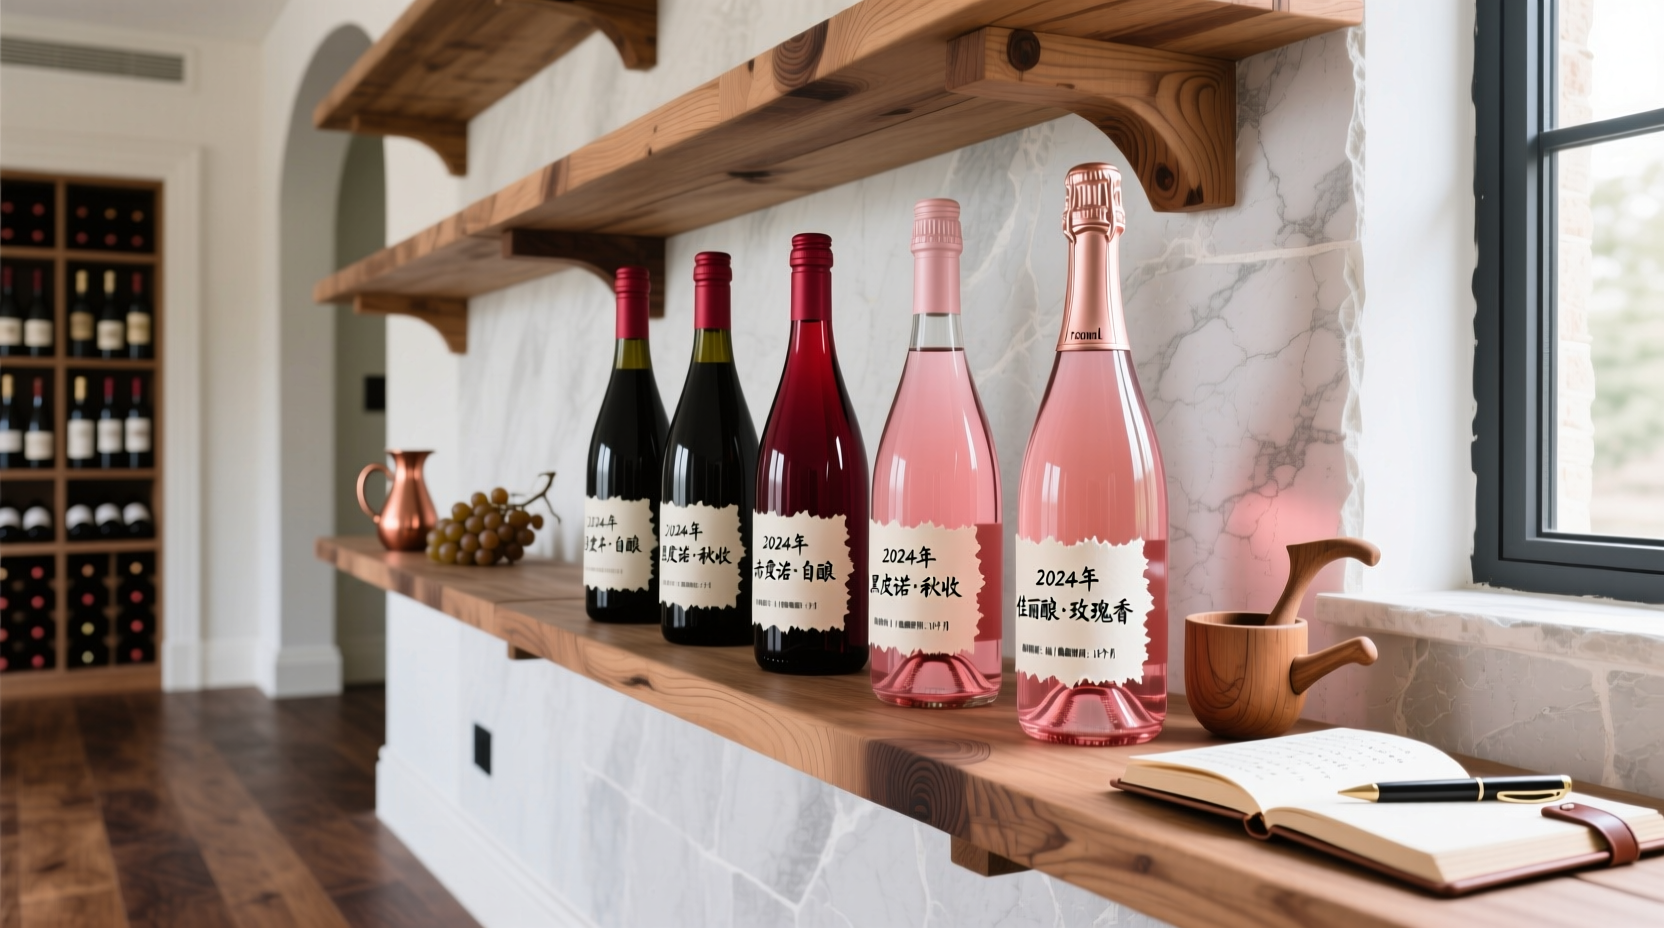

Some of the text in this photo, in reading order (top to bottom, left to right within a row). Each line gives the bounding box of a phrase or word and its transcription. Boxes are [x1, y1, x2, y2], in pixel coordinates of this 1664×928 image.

[762, 533, 809, 556] 2024年
[882, 546, 937, 569] 2024年
[1035, 566, 1100, 592] 2024年
